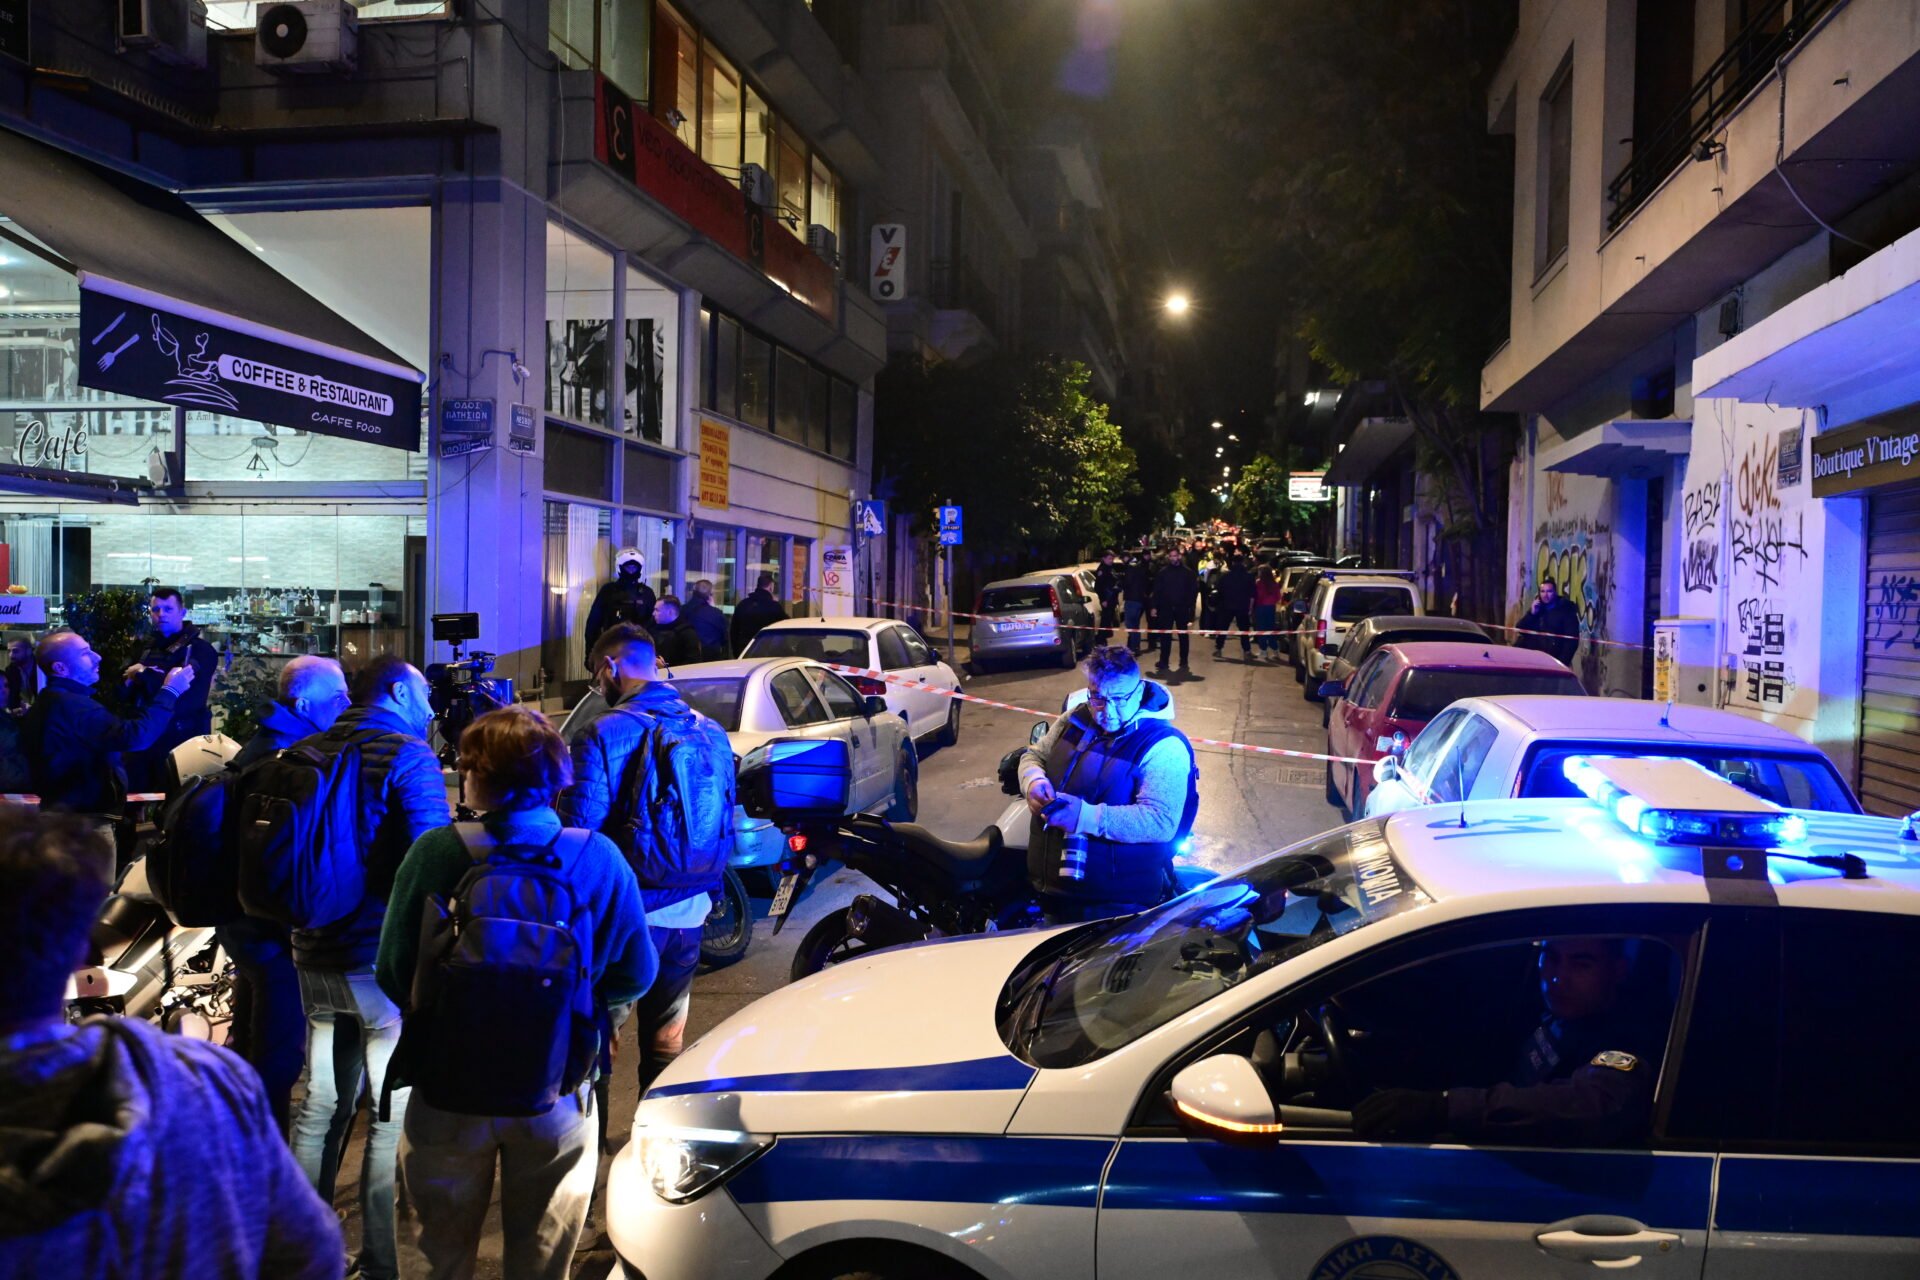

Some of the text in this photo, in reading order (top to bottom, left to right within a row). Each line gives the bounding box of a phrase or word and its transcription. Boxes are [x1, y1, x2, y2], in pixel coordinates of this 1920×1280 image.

[232, 359, 387, 413] COFFEE & RESTAURANT
[446, 411, 488, 420] ΠΑΤΗΣΙΩΝ
[454, 401, 481, 409] ΟΔΟΣ
[311, 411, 382, 434] CAFFE FOOD
[18, 420, 88, 471] Café
[1813, 447, 1865, 479] Boutique
